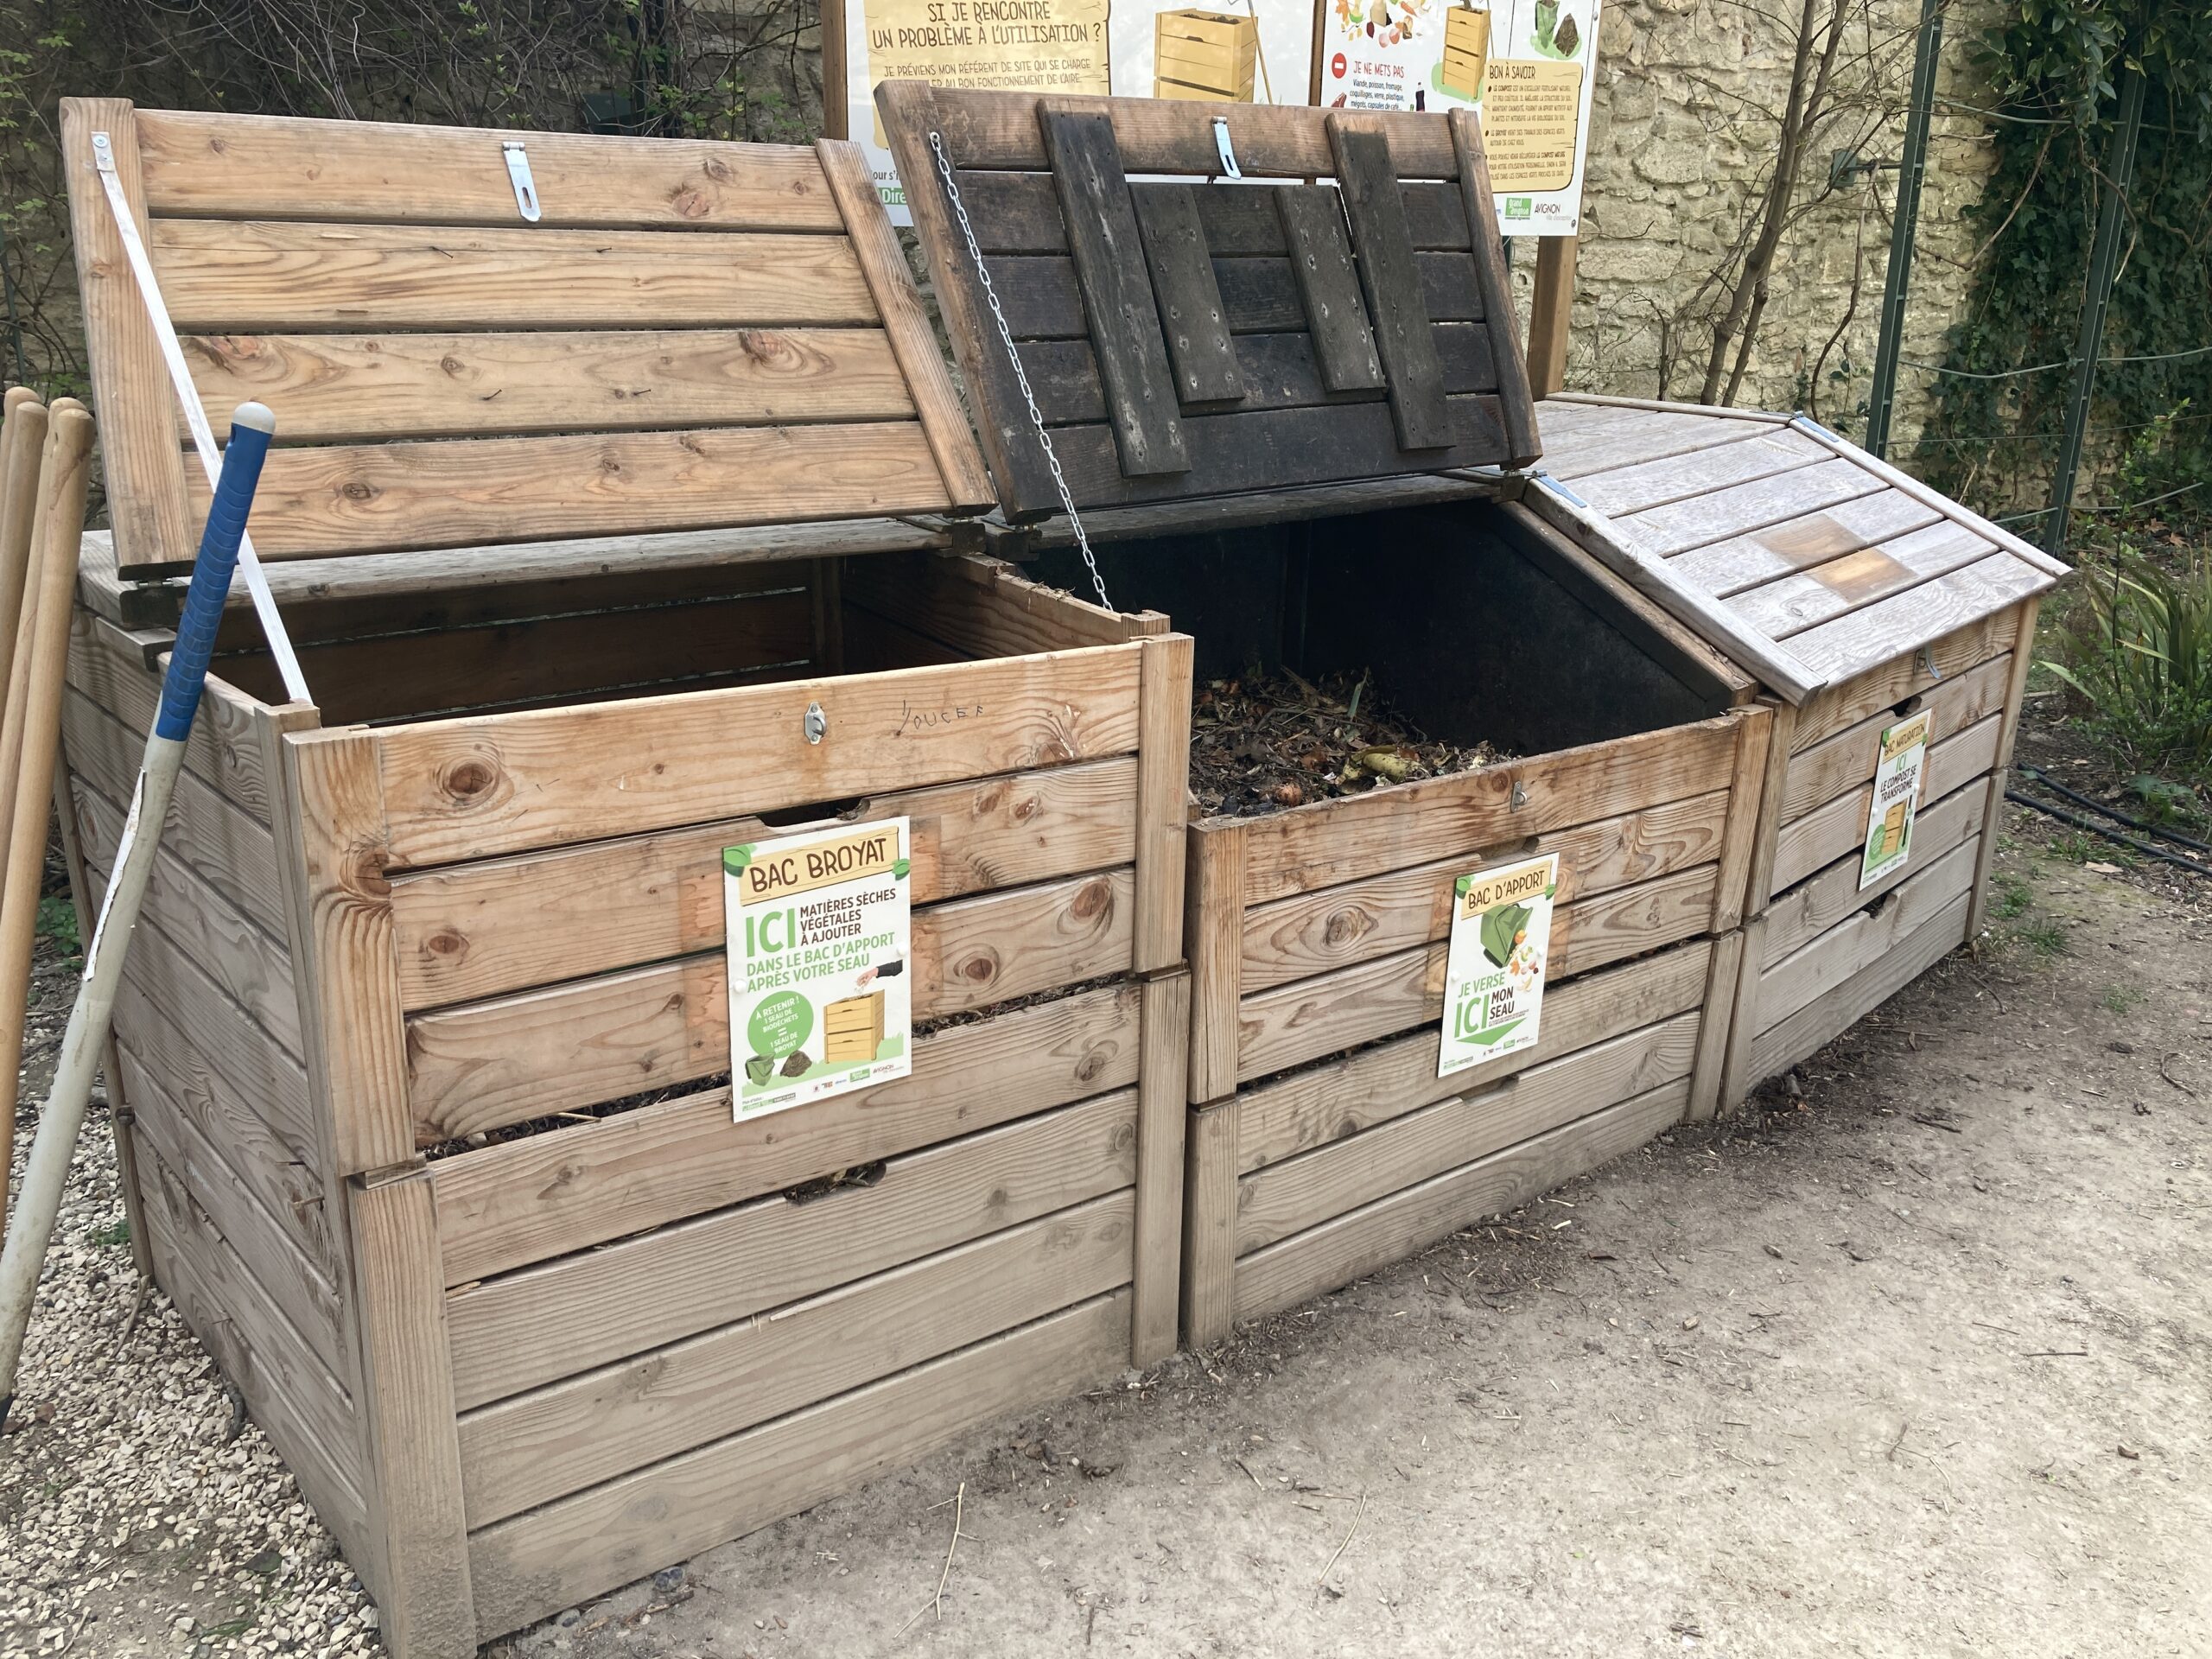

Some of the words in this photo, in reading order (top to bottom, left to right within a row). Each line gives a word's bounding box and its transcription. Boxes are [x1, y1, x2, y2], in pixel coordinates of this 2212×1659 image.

[929, 3, 946, 22] SI
[952, 2, 969, 22] JE
[974, 1, 1052, 23] RENCONTRE
[872, 29, 894, 49] UN
[899, 22, 973, 48] PROBLÈME
[978, 21, 988, 44] À
[994, 23, 1089, 45] L'UTILISATION
[1093, 22, 1102, 42] ?
[884, 66, 894, 77] JE
[898, 61, 936, 77] PRÉVIENS
[938, 63, 957, 75] MON
[959, 60, 998, 74] RÉFÉRENT
[1001, 61, 1013, 73] DE
[1014, 60, 1033, 72] SITE
[1034, 60, 1047, 71] QUI
[1050, 60, 1059, 71] SE
[1062, 58, 1091, 71] CHARGE
[1353, 60, 1362, 74] JE
[1363, 62, 1372, 75] NE
[1375, 63, 1391, 77] METS
[1393, 65, 1405, 79] PAS
[1489, 65, 1503, 79] BON
[1505, 61, 1510, 79] À
[1511, 66, 1536, 79] SAVOIR
[957, 77, 976, 88] BON
[977, 74, 1045, 87] FONCTIONNEMENT
[1047, 73, 1058, 85] DE
[1060, 73, 1081, 84] L'AIRE
[1352, 79, 1368, 88] Viande,
[1385, 82, 1403, 92] fromage,
[872, 170, 887, 180] our
[881, 188, 907, 204] Dire
[1535, 204, 1560, 214] AVIGNON
[1885, 739, 1895, 756] BAC
[1896, 723, 1925, 747] MATURATION
[1896, 753, 1907, 772] ICI
[1880, 780, 1888, 792] LE
[1887, 767, 1910, 789] COMPOST
[1910, 764, 1917, 777] SE
[1880, 778, 1914, 804] TRANSFORME
[749, 858, 798, 893] BAC
[806, 837, 887, 879] BROYAT
[1468, 887, 1491, 909] BAC
[1496, 870, 1545, 900] D'APPORT
[800, 897, 854, 918] MATIÈRES
[856, 887, 896, 906] SÈCHES
[800, 908, 861, 932] VÉGÉTALES
[746, 907, 797, 957] ICI
[800, 931, 809, 946] À
[811, 923, 861, 944] AJOUTER
[747, 957, 783, 977] DANS
[786, 951, 801, 969] LE
[804, 946, 830, 964] BAC
[833, 931, 895, 957] D'APPORT
[747, 970, 790, 993] APRÈS
[793, 962, 835, 982] VOTRE
[837, 953, 870, 972] SEAU
[1458, 982, 1471, 998] JE
[1473, 971, 1506, 993] VERSE
[1491, 986, 1514, 1004] MON
[756, 1010, 762, 1020] À
[762, 997, 796, 1017] RETENIR
[768, 1012, 784, 1023] SEAU
[784, 1007, 792, 1016] DE
[1454, 994, 1490, 1039] ICI
[1489, 1001, 1515, 1020] SEAU
[762, 1013, 799, 1033] BIODÉCHETS
[774, 1036, 790, 1046] SEAU
[790, 1031, 798, 1039] DE
[774, 1039, 797, 1053] BROYAT
